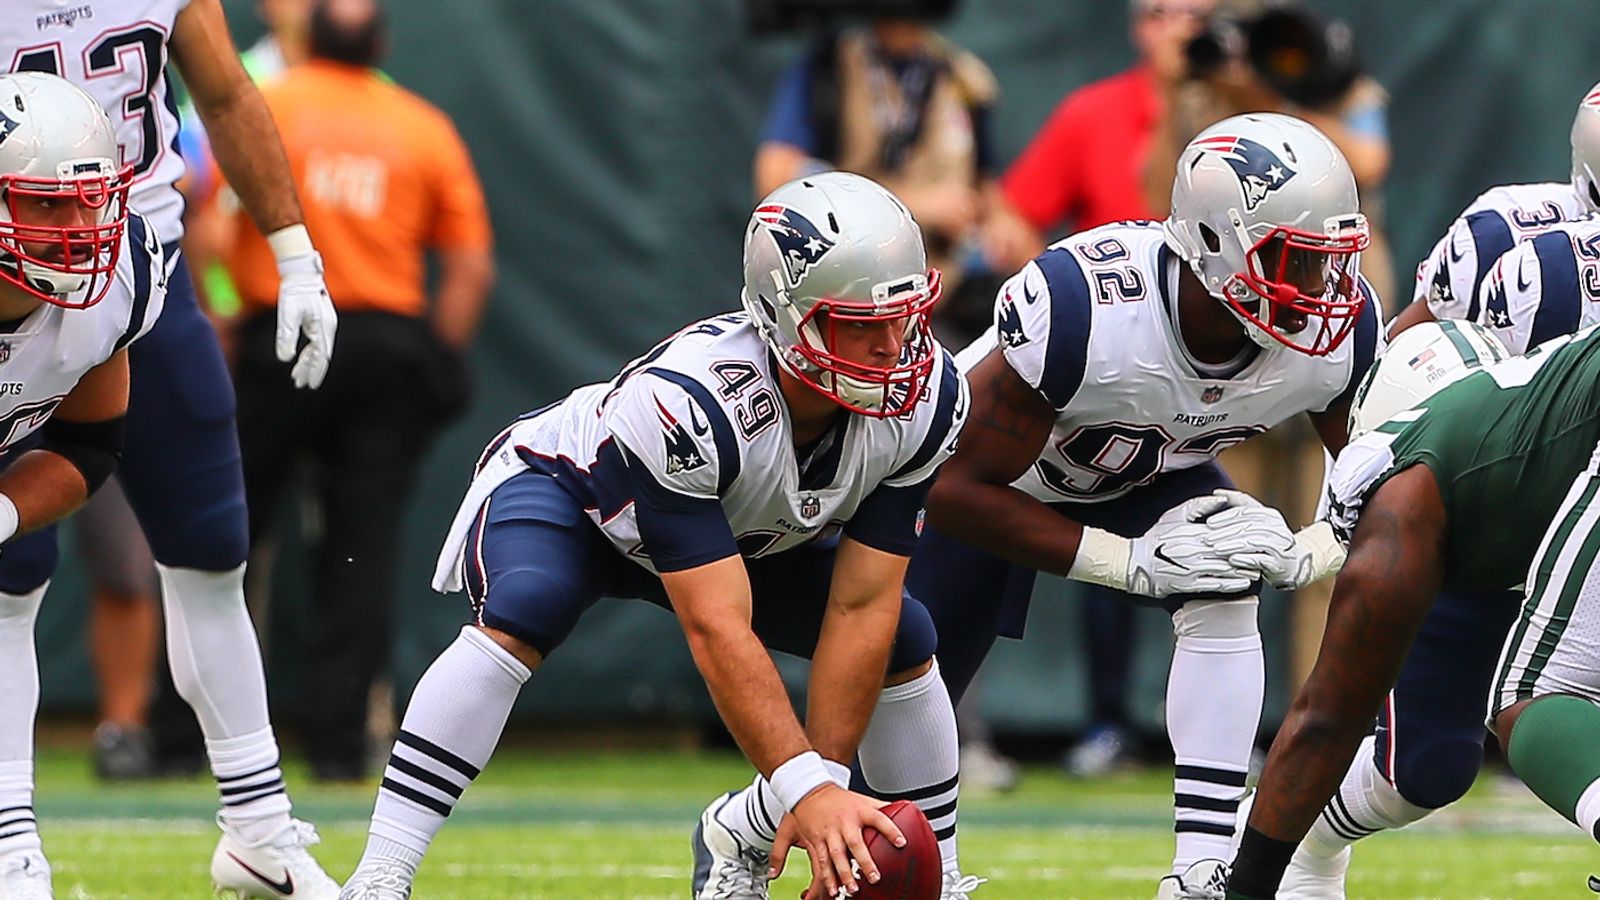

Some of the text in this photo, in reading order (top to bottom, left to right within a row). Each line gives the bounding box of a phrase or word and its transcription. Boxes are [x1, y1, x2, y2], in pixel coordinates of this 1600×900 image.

[36, 5, 93, 31] PATRIOTS
[1079, 238, 1148, 305] 92
[709, 359, 780, 441] 49
[1172, 413, 1229, 427] PATRIOTS
